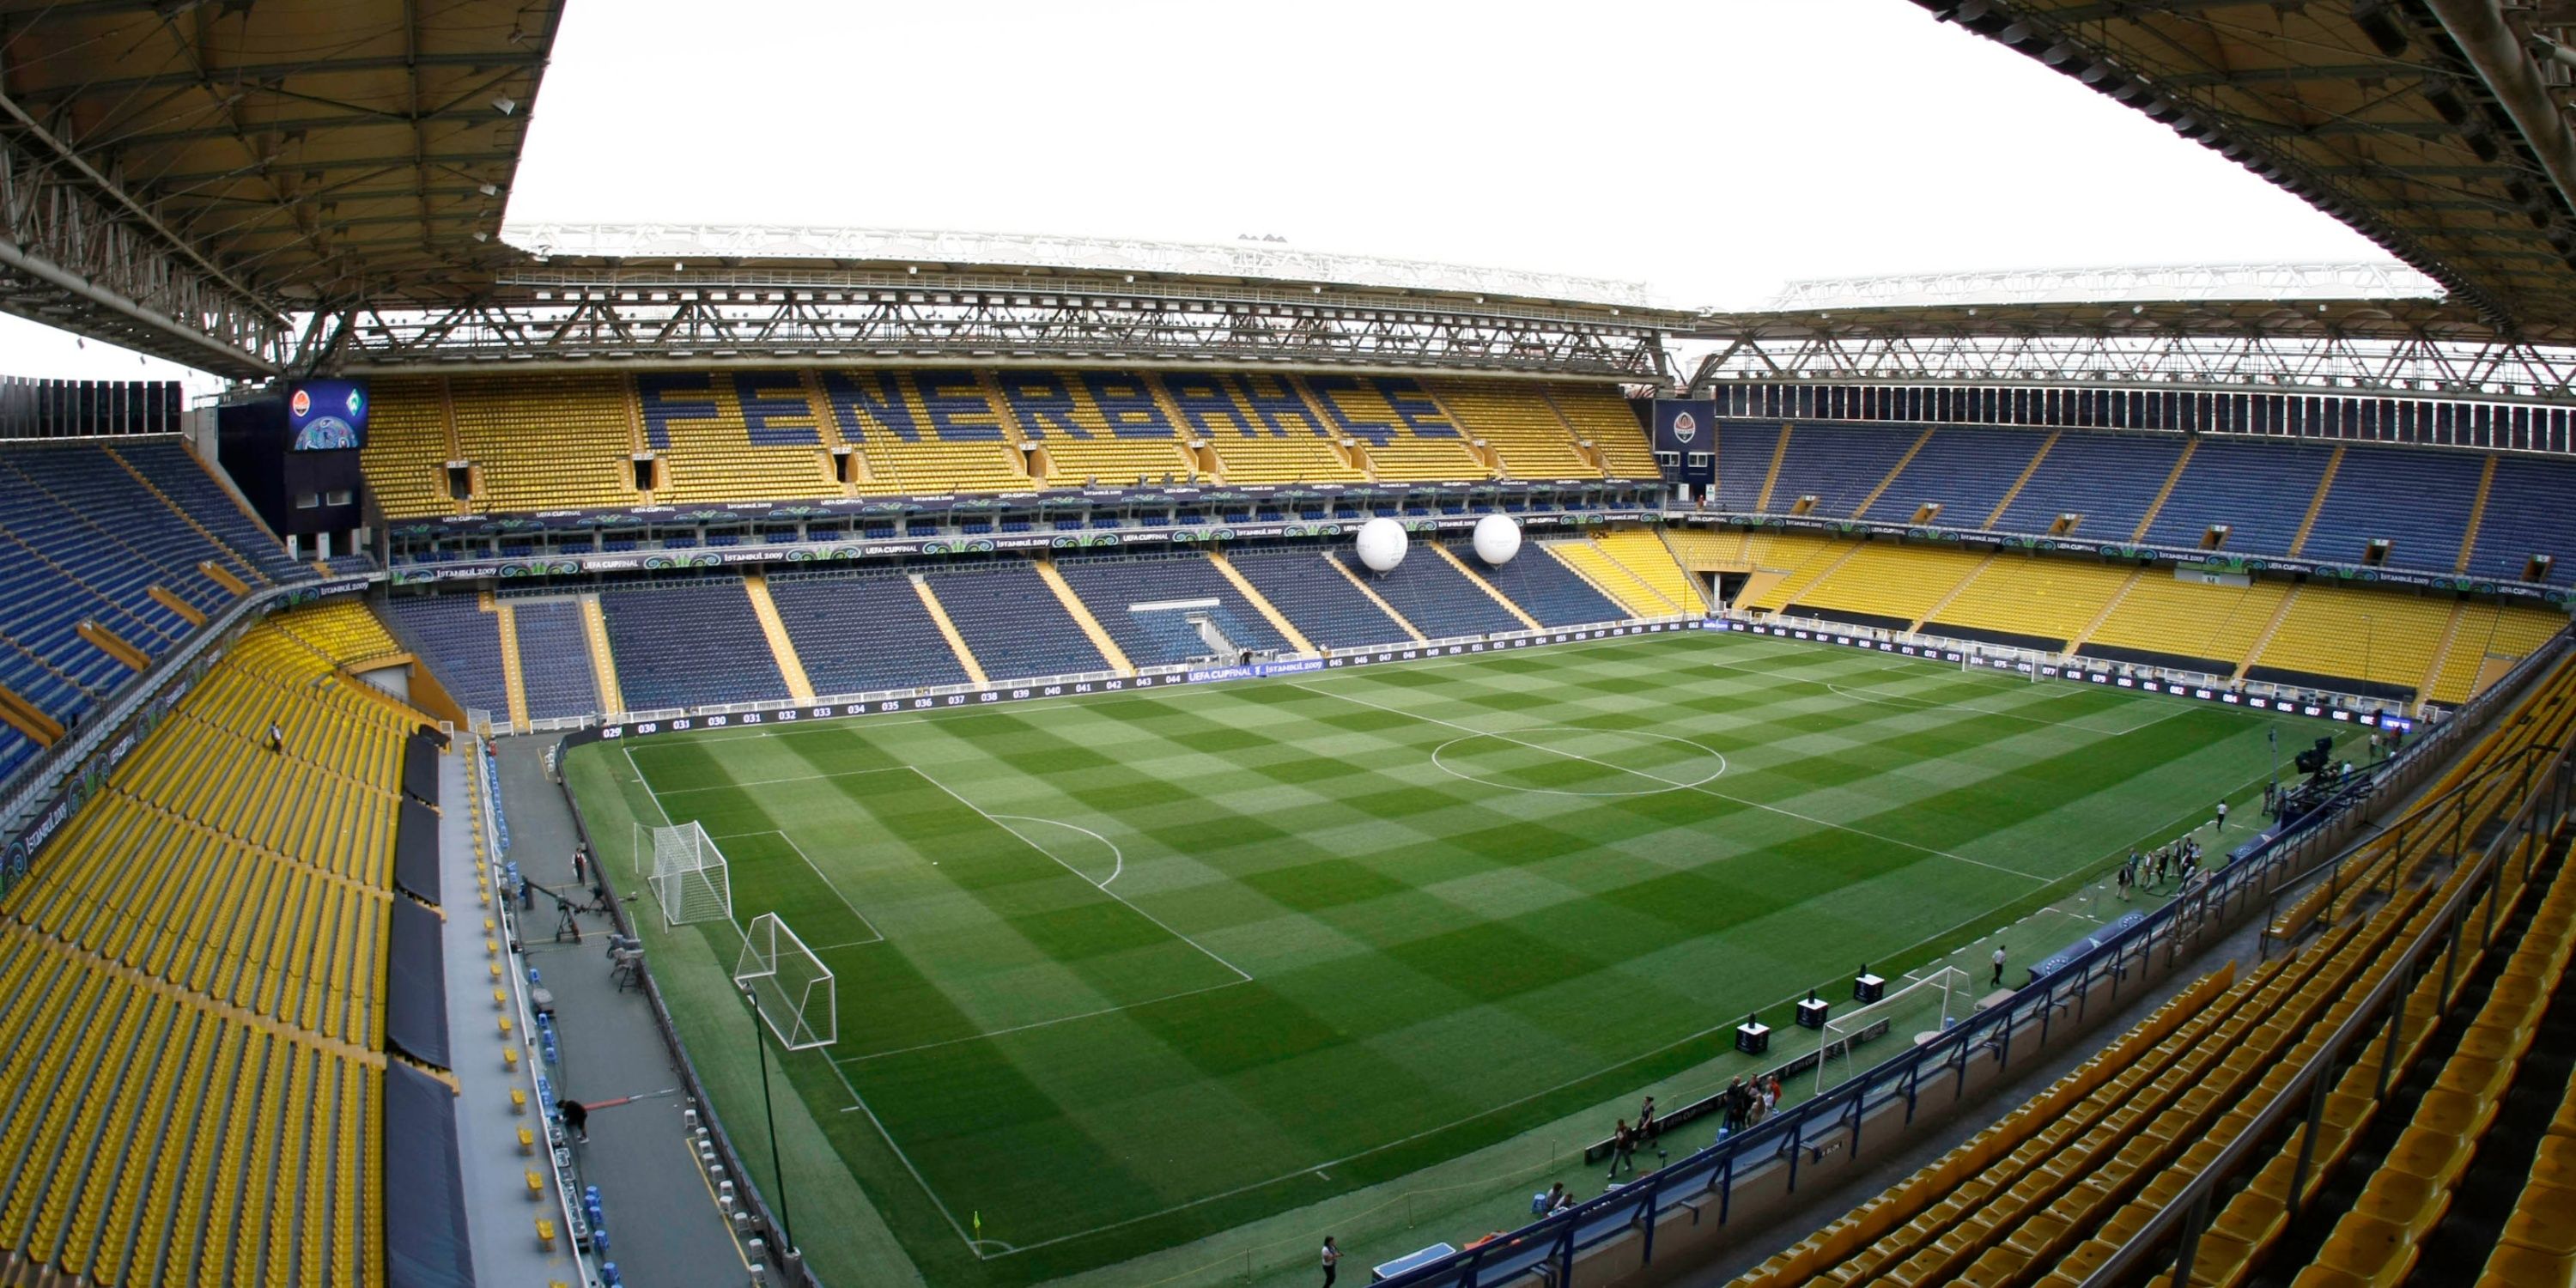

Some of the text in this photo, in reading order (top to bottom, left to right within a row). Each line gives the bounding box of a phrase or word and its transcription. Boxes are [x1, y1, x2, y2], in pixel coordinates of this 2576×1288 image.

[636, 370, 1461, 448] FENERBAHÇE
[1329, 659, 1343, 667] 045
[1354, 656, 1367, 665] 046
[1379, 653, 1392, 662] 047
[1403, 651, 1416, 659] 048
[1426, 647, 1439, 657] 049
[1449, 646, 1461, 654] 050
[1472, 643, 1484, 652] 051
[1493, 641, 1505, 650] 052
[1515, 639, 1527, 647] 053
[1535, 636, 1546, 645] 054
[1555, 635, 1566, 643] 055
[1576, 632, 1586, 641] 056
[603, 674, 1181, 739] 029 030 031 030 031 032 033 034 035 036 037 038 039 040 041 042 043 044
